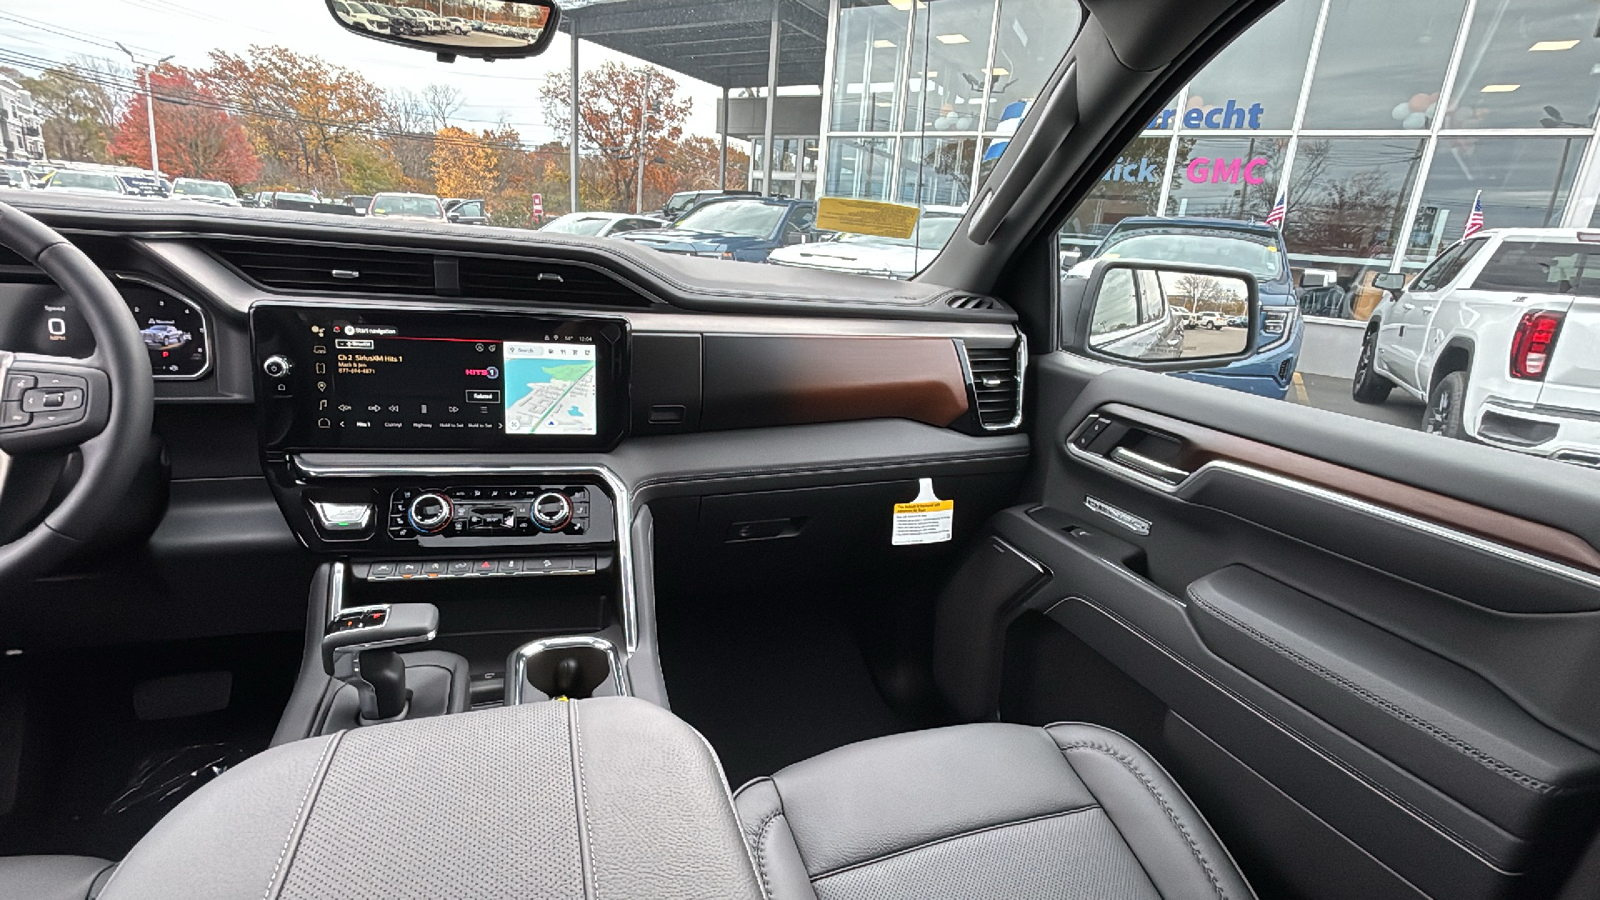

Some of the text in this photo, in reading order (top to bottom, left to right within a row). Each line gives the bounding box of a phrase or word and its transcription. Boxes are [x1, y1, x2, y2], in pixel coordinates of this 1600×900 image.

[1186, 157, 1268, 185] GMC
[44, 304, 66, 312] Speed
[47, 317, 66, 336] 0
[369, 328, 397, 336] navigation
[354, 354, 384, 362] SiriusXM
[384, 355, 398, 363] Hits
[398, 355, 403, 363] 1
